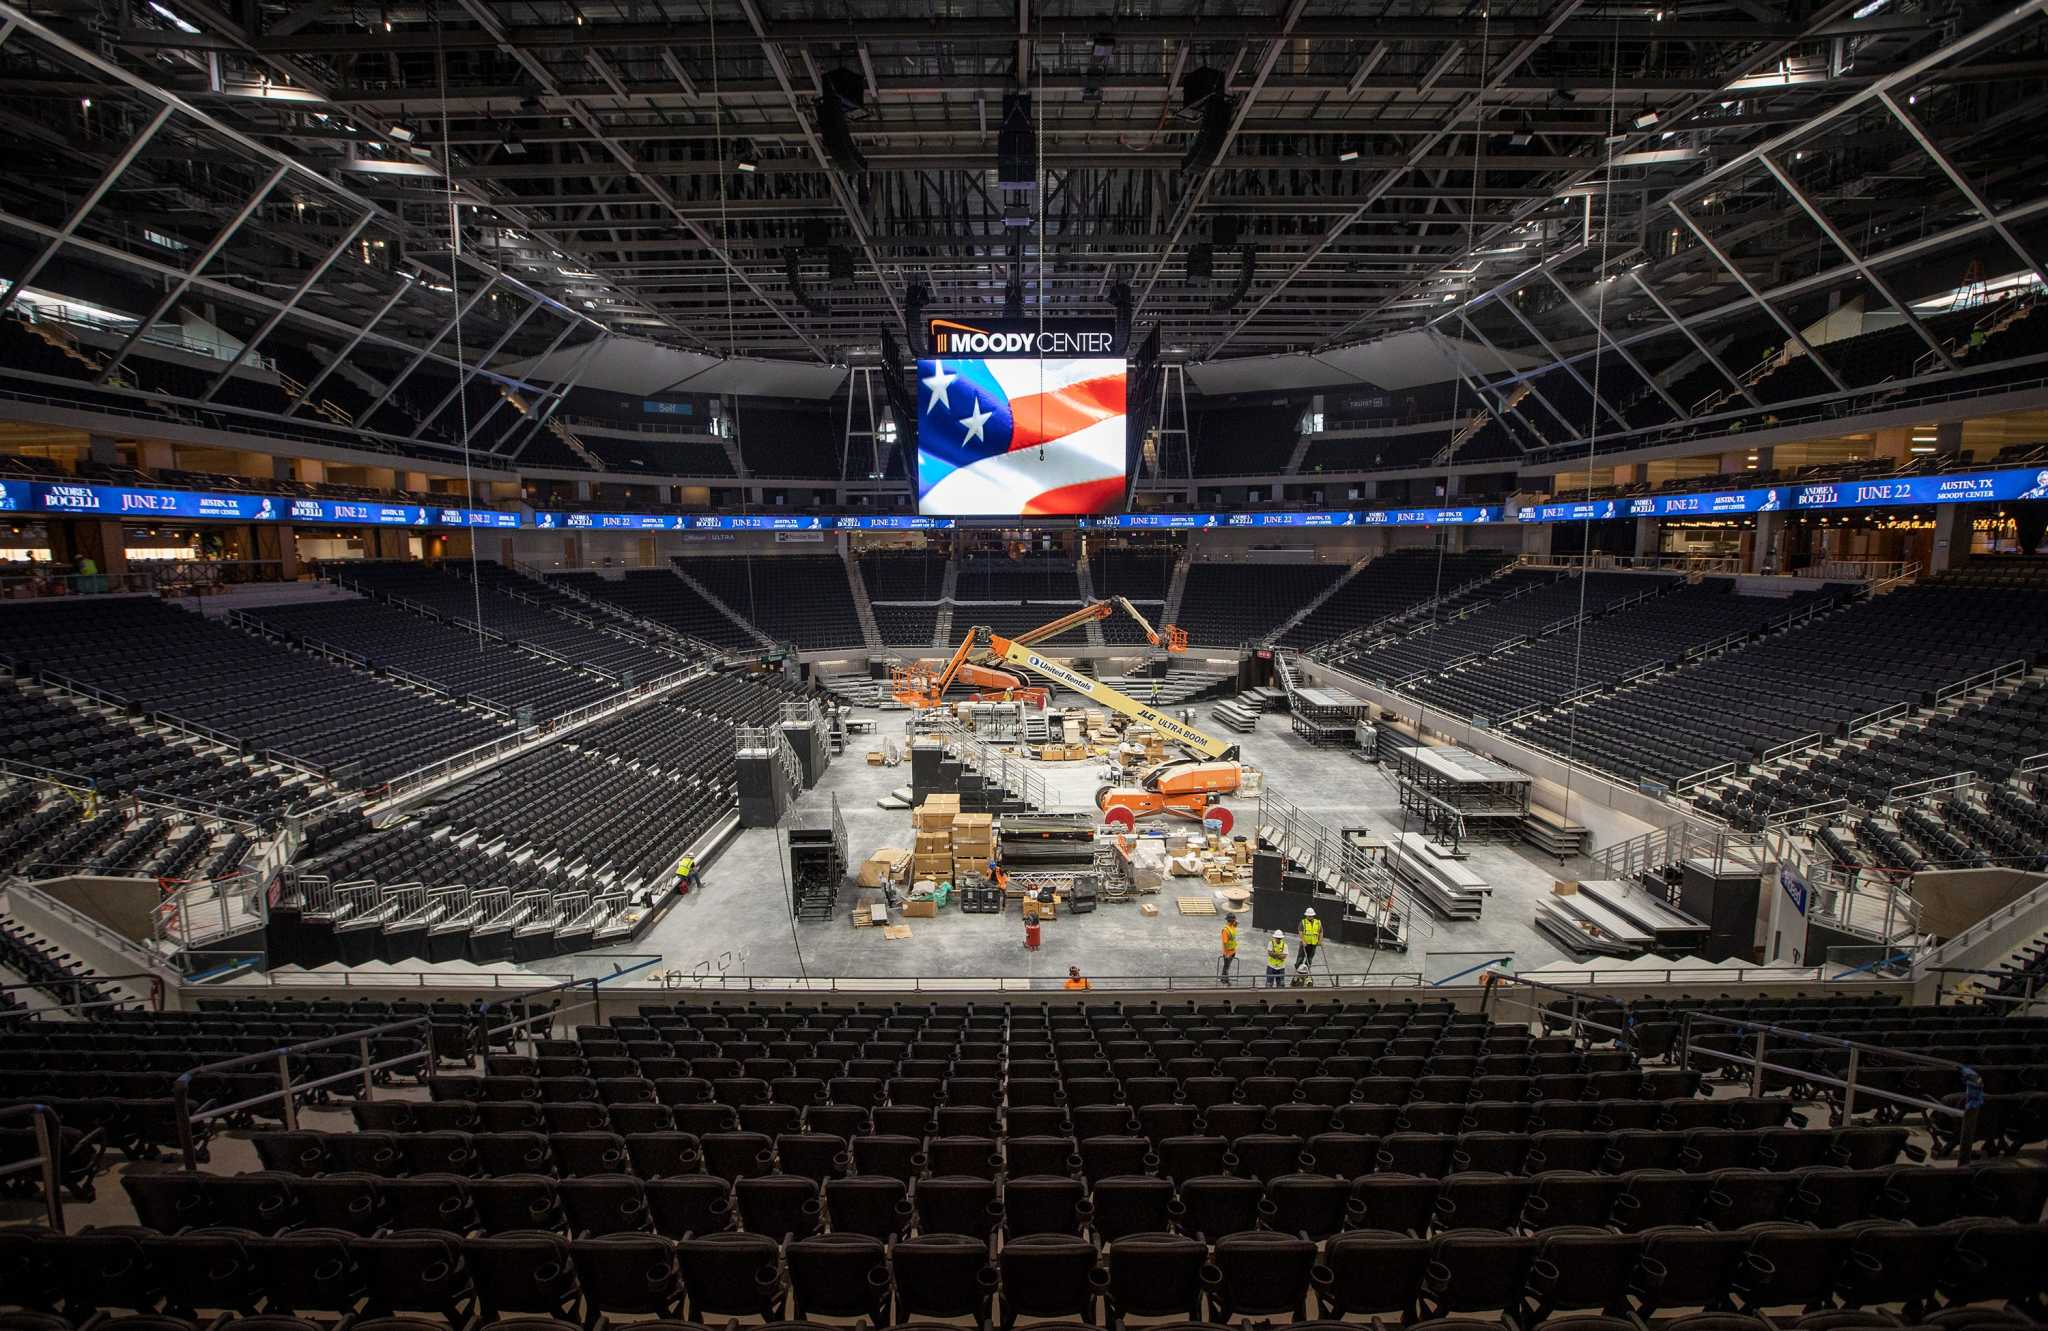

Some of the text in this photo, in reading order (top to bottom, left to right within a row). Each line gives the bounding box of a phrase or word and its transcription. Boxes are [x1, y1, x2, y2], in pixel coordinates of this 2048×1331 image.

[951, 332, 1113, 353] MOODY CENTER
[1940, 479, 1993, 490] AUSTIN, TX
[51, 486, 93, 497] ANDREA
[1803, 487, 1833, 495] ANDREA
[1856, 484, 1911, 503] JUNE 22
[1937, 490, 1994, 499] MOODY CENTER
[45, 494, 100, 508] BOCELLI
[122, 494, 176, 510] JUNE 22
[200, 499, 238, 508] AUSTIN, TX
[1798, 493, 1838, 504] BOCELLI
[295, 500, 320, 509] ANDREA
[1630, 504, 1655, 513] BOCELLI
[1665, 499, 1698, 512] JUNE 22
[291, 508, 323, 516] BOCELLI
[334, 506, 368, 518] JUNE 22
[1542, 508, 1557, 519] JUNE
[1558, 508, 1564, 516] 22
[469, 513, 482, 523] JUNE
[483, 515, 490, 523] 22
[602, 517, 631, 527] JUNE 22
[1130, 517, 1148, 525] JUNE
[1264, 516, 1282, 524] JUNE
[1397, 513, 1415, 522] JUNE
[732, 518, 751, 528] JUNE
[871, 519, 888, 527] JUNE
[1040, 661, 1092, 691] United Rentals
[1137, 709, 1208, 747] JLG ULTRA BOOM
